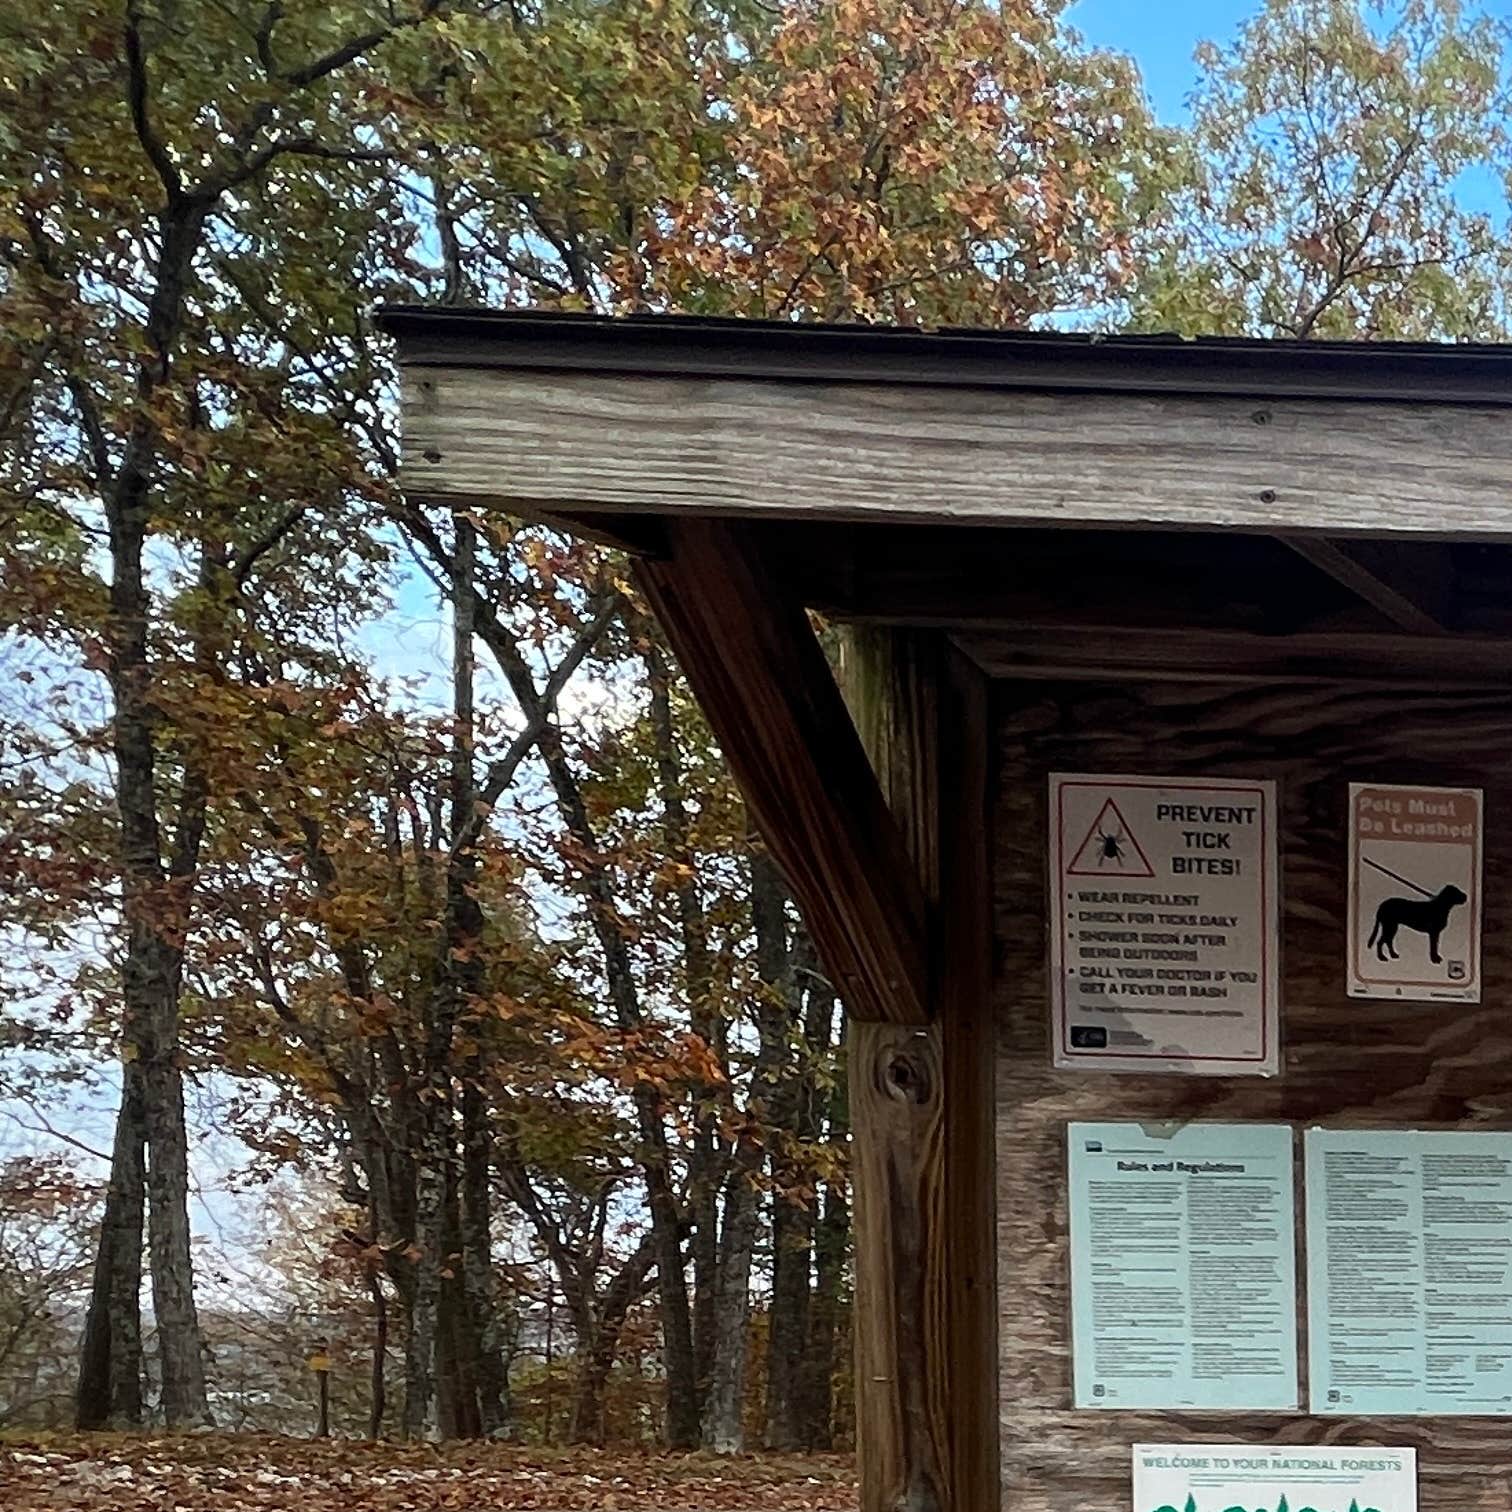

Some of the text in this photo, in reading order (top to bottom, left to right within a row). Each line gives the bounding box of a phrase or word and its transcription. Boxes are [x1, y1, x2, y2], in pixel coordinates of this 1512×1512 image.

[1157, 804, 1257, 824] PREVENT
[1408, 799, 1456, 817] Must
[1391, 818, 1473, 837] Leashed
[1182, 831, 1231, 849] TICK
[1172, 857, 1241, 876] BITES!
[1079, 966, 1112, 978] CALL
[1142, 1457, 1402, 1471] WELCOME TO YOUR NATIONAL FORESTS
